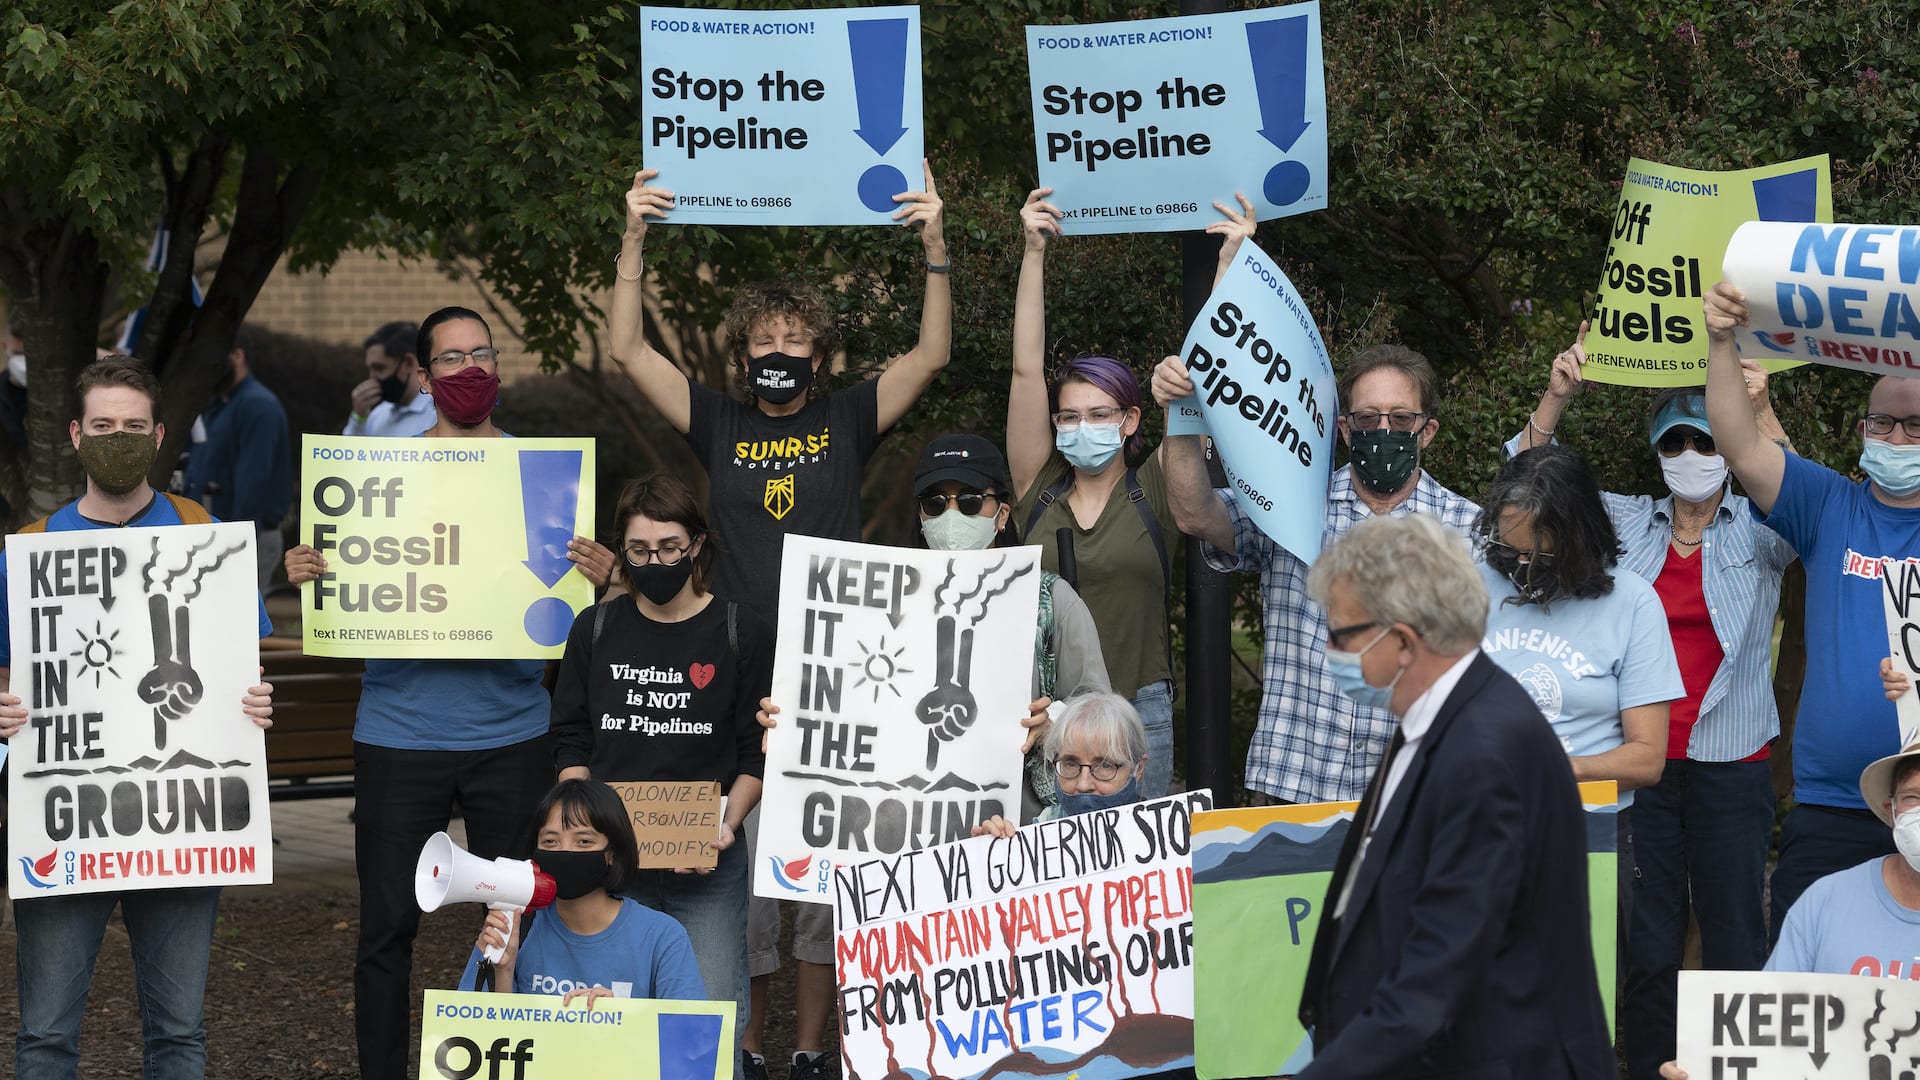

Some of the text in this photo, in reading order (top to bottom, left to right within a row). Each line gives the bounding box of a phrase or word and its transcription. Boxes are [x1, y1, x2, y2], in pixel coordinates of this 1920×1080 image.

[651, 20, 815, 35] FOOD & WATER ACTION!
[1038, 26, 1212, 50] FOOD & WATER ACTION!
[652, 68, 825, 112] Stop the
[1042, 76, 1226, 124] Stop the
[652, 115, 808, 159] Pipeline
[1046, 125, 1212, 172] Pipeline
[680, 196, 732, 207] PIPELINE
[736, 197, 748, 208] to
[751, 197, 792, 208] 69866
[1642, 174, 1664, 190] WATER
[1664, 179, 1718, 196] ACTION!
[1060, 202, 1198, 218] ext PIPELINE to 69866
[1614, 200, 1652, 245] Off
[1244, 255, 1277, 289] FOOD
[1276, 286, 1284, 299] &
[1284, 293, 1309, 334] WATER
[1210, 302, 1292, 384] Stop
[1598, 354, 1678, 370] RENEWABLES
[1682, 360, 1694, 370] to
[757, 377, 796, 388] PIPELINE
[762, 369, 787, 378] STOP
[1185, 342, 1312, 468] Pipeline
[1298, 376, 1325, 439] the
[313, 448, 485, 462] FOOD & WATER ACTION!
[736, 428, 830, 460] SUNRSE
[313, 476, 404, 518] Off
[1238, 479, 1274, 512] 69866
[314, 522, 460, 566] Fossil
[30, 546, 126, 612] KEEP
[314, 572, 448, 614] Fuels
[806, 554, 920, 629] KEEP
[31, 605, 62, 654] IT
[314, 628, 492, 642] text RENEWABLES to 69866
[803, 608, 843, 657] IT
[32, 660, 68, 709] IN
[610, 664, 684, 685] Virginia
[800, 662, 843, 714] IN
[626, 689, 690, 710] is NOT
[32, 712, 104, 763] THE
[601, 714, 712, 736] for Pipelines
[796, 717, 878, 772] THE
[44, 776, 250, 842] GROUND
[64, 850, 75, 885] OUR
[80, 846, 256, 880] REVOLUTION
[818, 859, 830, 894] OUR
[834, 850, 923, 930] NEXT
[933, 844, 972, 903] VA
[988, 809, 1125, 894] GOVERNOR
[837, 905, 992, 987] MOUNTAIN
[996, 883, 1092, 950] VALLEY
[838, 974, 924, 1036] FROM
[934, 941, 1112, 1015] POLLUTING
[436, 1004, 622, 1024] FOOD & WATER ACTION!
[936, 990, 1106, 1059] WATER
[1712, 993, 1845, 1070] KEEP
[434, 1036, 534, 1080] Off
